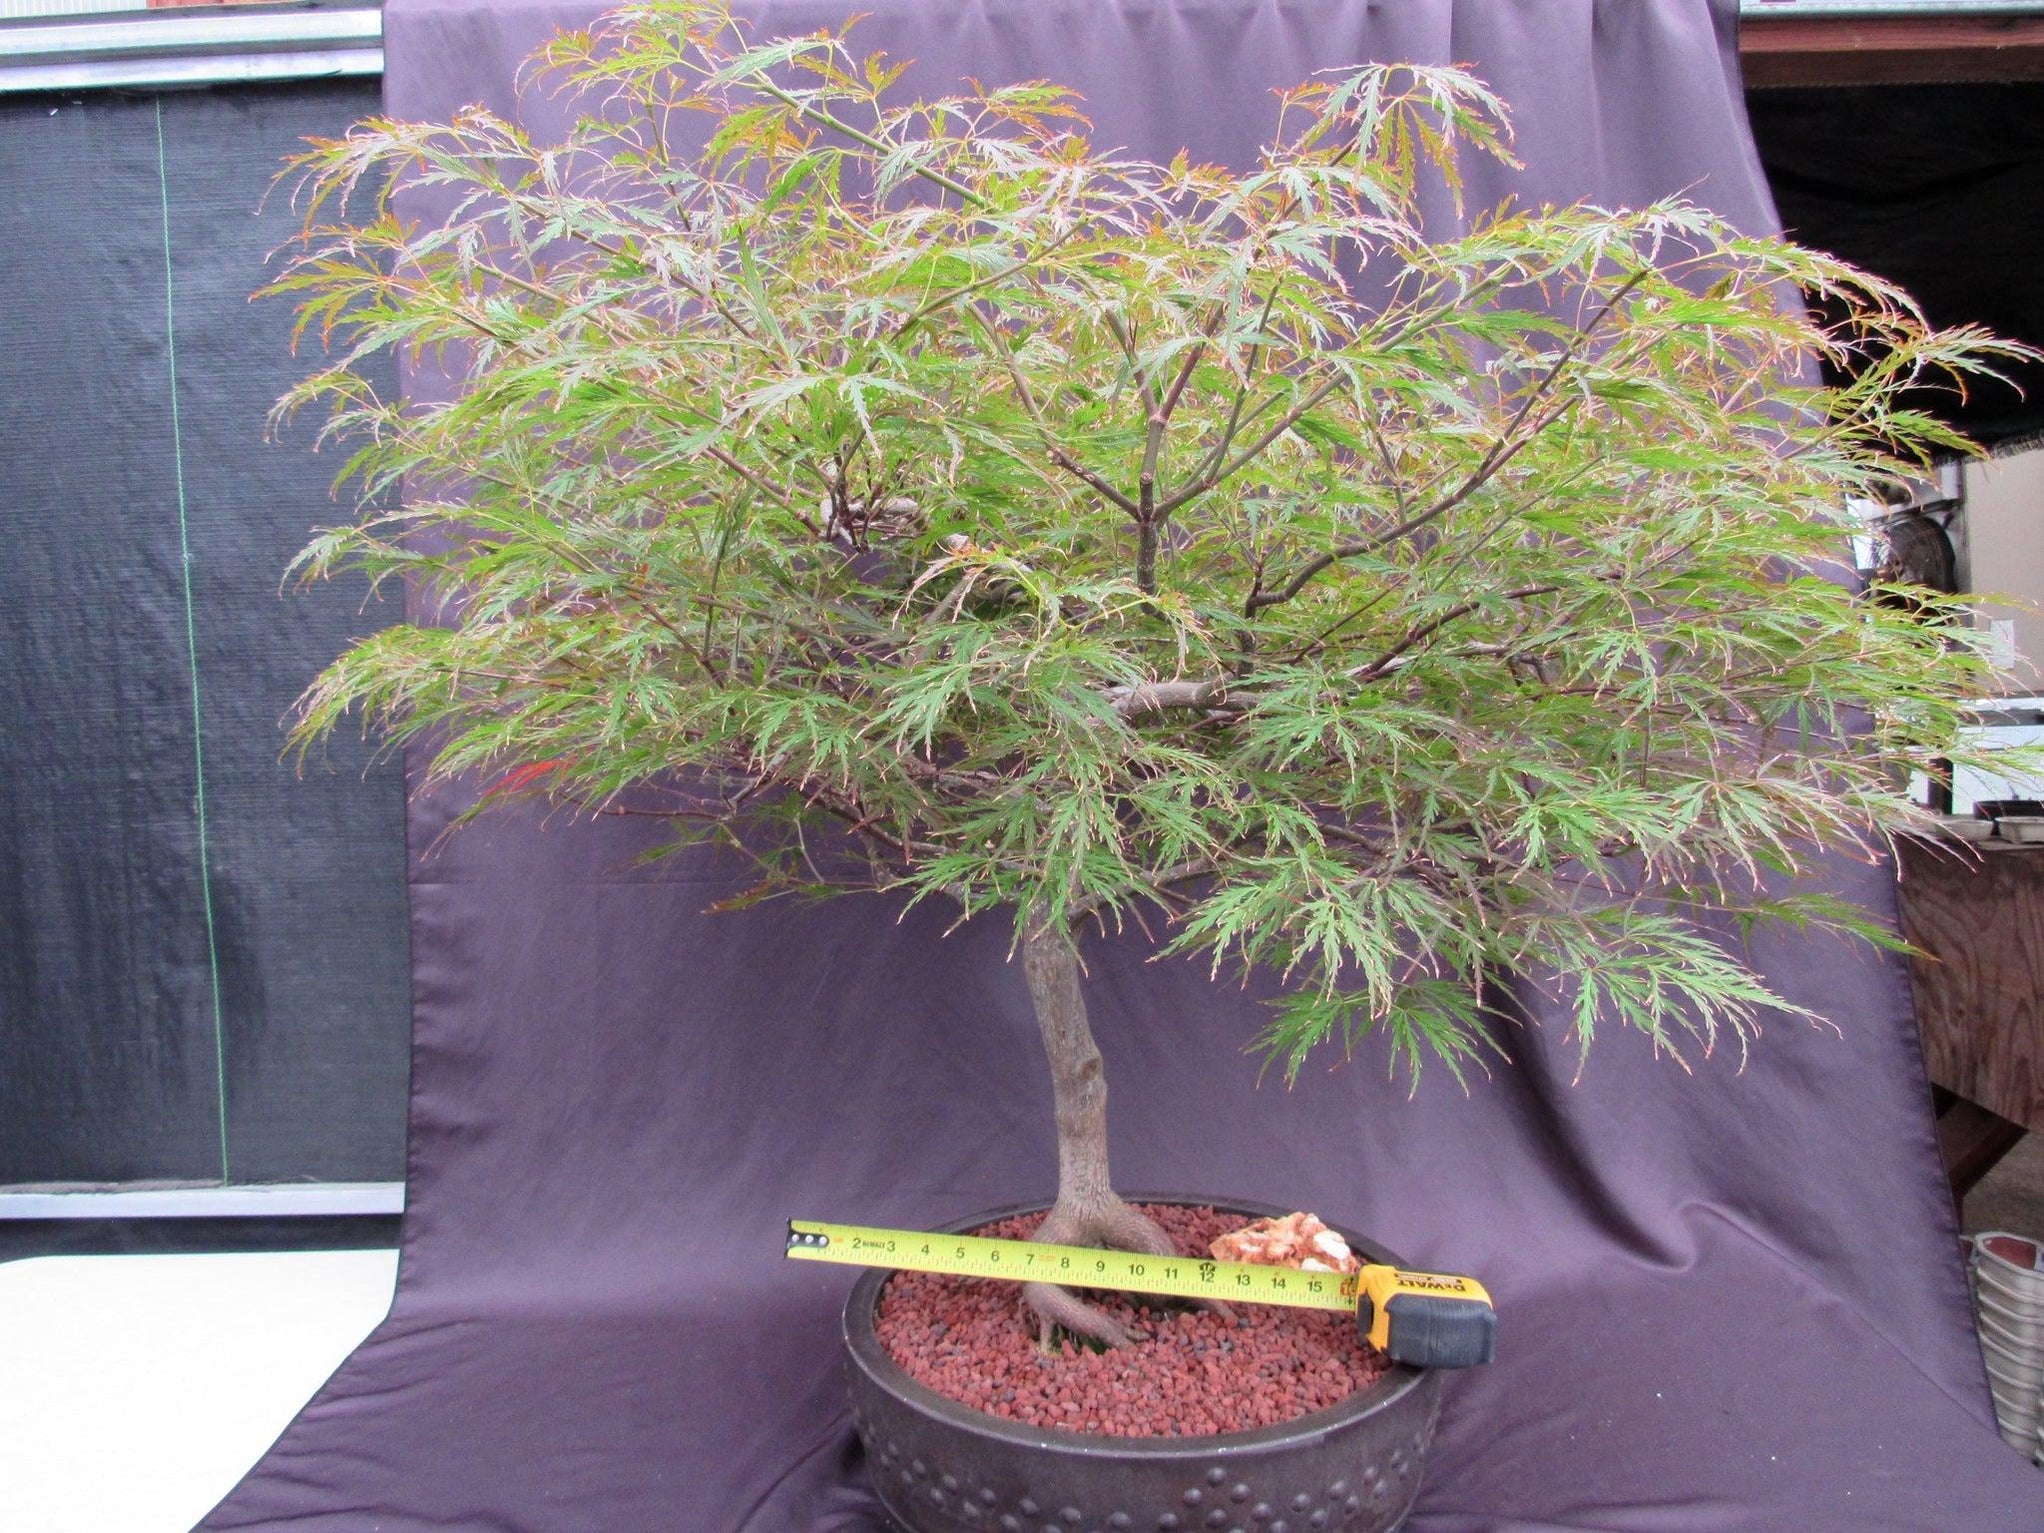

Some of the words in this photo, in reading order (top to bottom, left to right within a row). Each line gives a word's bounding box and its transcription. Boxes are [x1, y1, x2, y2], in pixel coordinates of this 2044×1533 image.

[852, 1238, 861, 1249] 2
[887, 1241, 895, 1252] 3
[921, 1244, 930, 1255] 4
[956, 1247, 965, 1259] 5
[991, 1250, 1000, 1262] 6
[1026, 1254, 1035, 1265] 7
[1061, 1257, 1070, 1268] 8
[1096, 1260, 1105, 1272] 9
[1129, 1264, 1144, 1276] 10
[1164, 1268, 1178, 1279] 11
[1199, 1271, 1215, 1282] 12
[1235, 1274, 1250, 1286] 13
[1271, 1277, 1286, 1289] 14
[1307, 1281, 1322, 1293] 15
